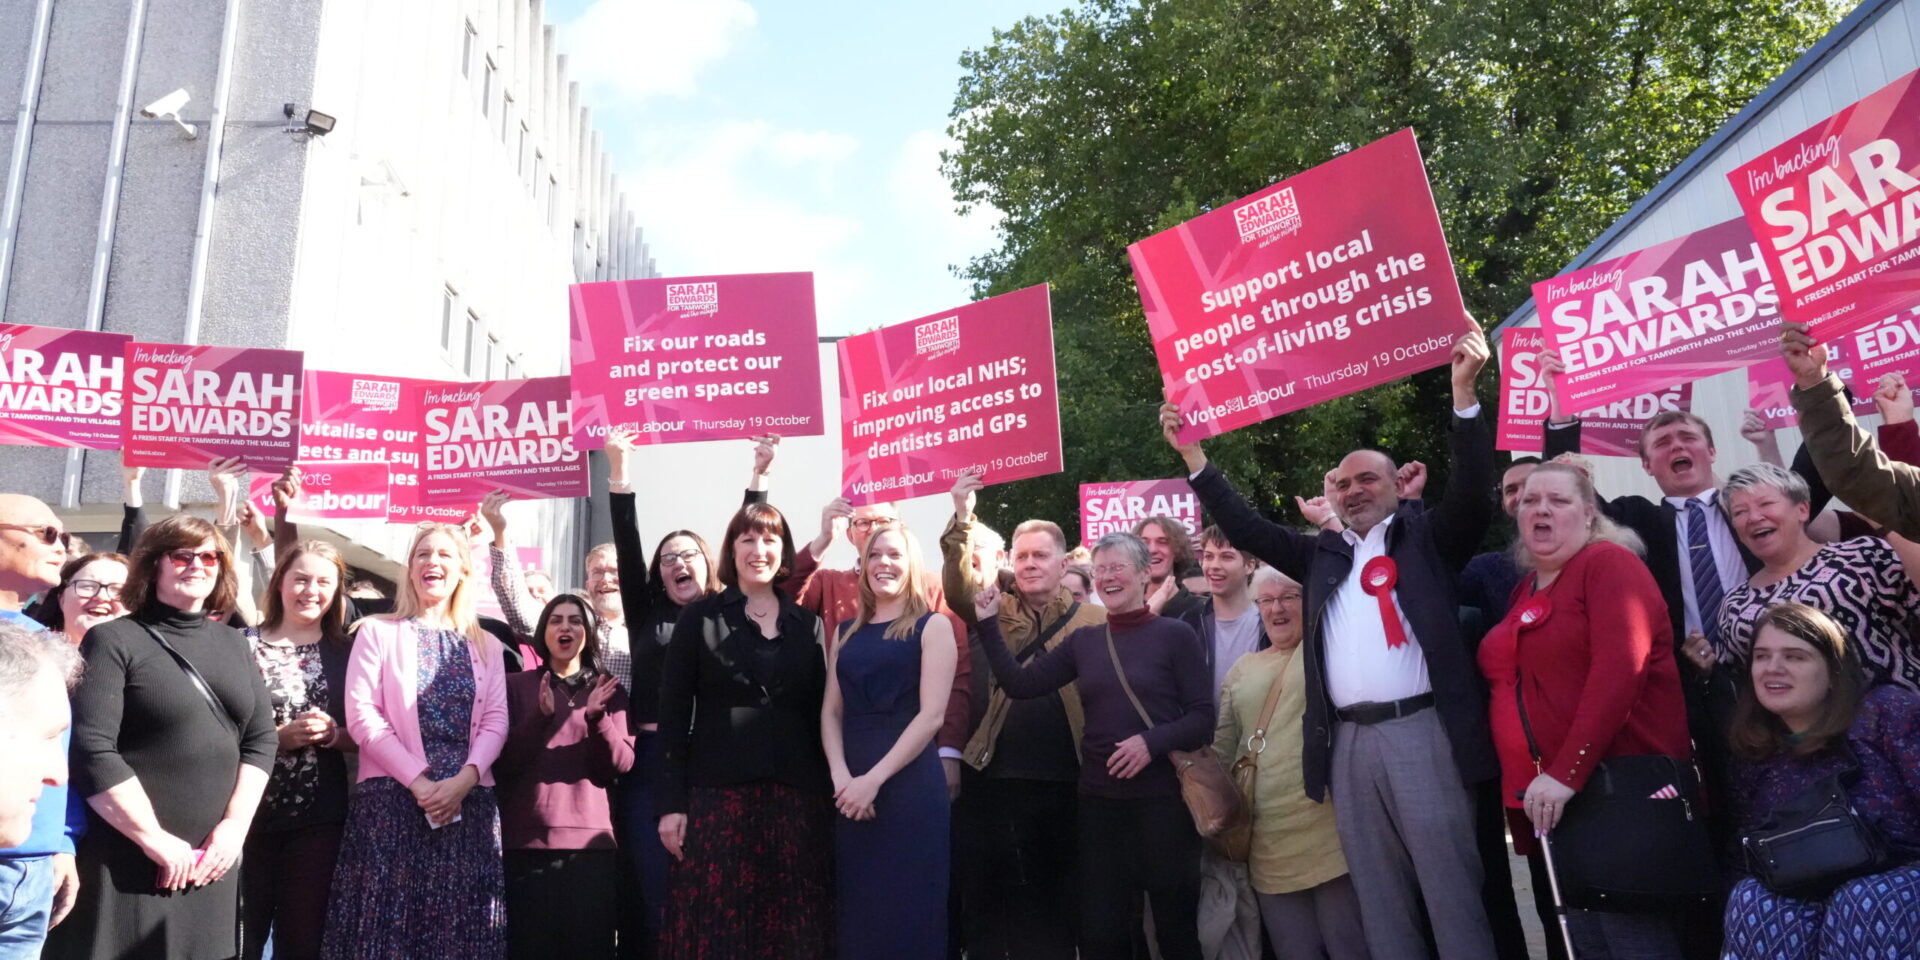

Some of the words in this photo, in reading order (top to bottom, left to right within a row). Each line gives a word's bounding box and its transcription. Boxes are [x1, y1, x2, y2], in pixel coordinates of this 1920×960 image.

[1748, 168, 1775, 196] I'm
[1774, 132, 1842, 184] backing
[1237, 190, 1293, 223] SARAH
[1760, 138, 1920, 251] SAR
[1240, 204, 1295, 233] EDWARDS
[1241, 233, 1257, 245] FOR
[1256, 215, 1302, 237] TAMWORTH
[1201, 259, 1302, 313] Support
[1305, 229, 1374, 275] local
[1796, 297, 1804, 308] A
[1804, 284, 1835, 304] FRESH
[1835, 269, 1867, 288] START
[1868, 260, 1890, 276] FOR
[669, 284, 715, 297] SARAH
[1547, 284, 1569, 303] I'm
[1570, 267, 1626, 295] backing
[1552, 242, 1772, 343] SARAH
[669, 295, 715, 305] EDWARDS
[680, 303, 718, 312] TAMWORTH
[1174, 311, 1257, 361] people
[1260, 270, 1370, 325] through
[1375, 252, 1426, 284] the
[623, 335, 655, 353] Fix
[660, 335, 699, 352] our
[705, 328, 766, 349] roads
[917, 318, 957, 338] SARAH
[918, 330, 957, 347] EDWARDS
[1184, 313, 1351, 385] cost-of-living
[1355, 284, 1433, 327] crisis
[1512, 332, 1530, 349] I'm
[1559, 282, 1780, 375] EDWARDS
[133, 347, 150, 363] I'm
[152, 348, 196, 374] backing
[1568, 377, 1575, 385] A
[1575, 371, 1601, 383] FRESH
[1602, 362, 1628, 376] START
[1629, 356, 1647, 367] FOR
[1648, 340, 1701, 361] TAMWORTH
[1703, 334, 1725, 346] AND
[1726, 328, 1745, 341] THE
[1726, 342, 1759, 357] Thursday
[1870, 356, 1894, 368] FRESH
[609, 359, 650, 379] and
[656, 355, 739, 380] protect
[744, 354, 782, 371] our
[1185, 401, 1228, 427] Vote
[1240, 380, 1297, 411] Labour
[1304, 360, 1369, 391] Thursday
[1371, 351, 1390, 368] 19
[1393, 331, 1455, 362] October
[132, 367, 294, 410] SARAH
[354, 391, 397, 400] EDWARDS
[355, 381, 398, 393] SARAH
[623, 386, 689, 407] green
[694, 379, 770, 402] spaces
[862, 390, 889, 410] Fix
[892, 383, 924, 402] our
[928, 366, 973, 394] local
[979, 356, 1027, 383] NHS;
[424, 390, 439, 406] I'm
[441, 389, 483, 410] backing
[853, 404, 946, 439] improving
[950, 388, 1015, 416] access
[1019, 382, 1042, 400] to
[1765, 405, 1798, 419] Vot
[11, 413, 54, 422] TAMWORTH
[55, 415, 72, 423] AND
[87, 417, 121, 426] VILLAGES
[132, 405, 292, 438] EDWARDS
[301, 421, 378, 440] vitalise
[383, 429, 418, 443] our
[425, 400, 573, 444] SARAH
[636, 420, 685, 434] Labour
[692, 417, 746, 431] Thursday
[748, 416, 762, 428] 19
[765, 414, 811, 427] October
[69, 431, 92, 439] Thursday
[191, 437, 230, 445] TAMWORTH
[260, 440, 290, 448] VILLAGES
[867, 430, 943, 460] dentists
[947, 418, 984, 444] and
[989, 412, 1027, 434] GPs
[348, 447, 386, 462] and
[426, 436, 580, 471] EDWARDS
[486, 469, 522, 477] TAMWORTH
[523, 467, 537, 475] AND
[551, 465, 581, 473] VILLAGES
[852, 480, 882, 496] Vote
[892, 470, 934, 489] Labour
[940, 461, 988, 480] Thursday
[989, 458, 1003, 471] 19
[1005, 451, 1048, 468] October
[306, 489, 386, 511] abour
[1098, 486, 1127, 500] backing
[411, 505, 424, 515] 19
[426, 505, 467, 517] October
[1086, 493, 1195, 522] SARAH
[1086, 517, 1196, 540] EDWS
